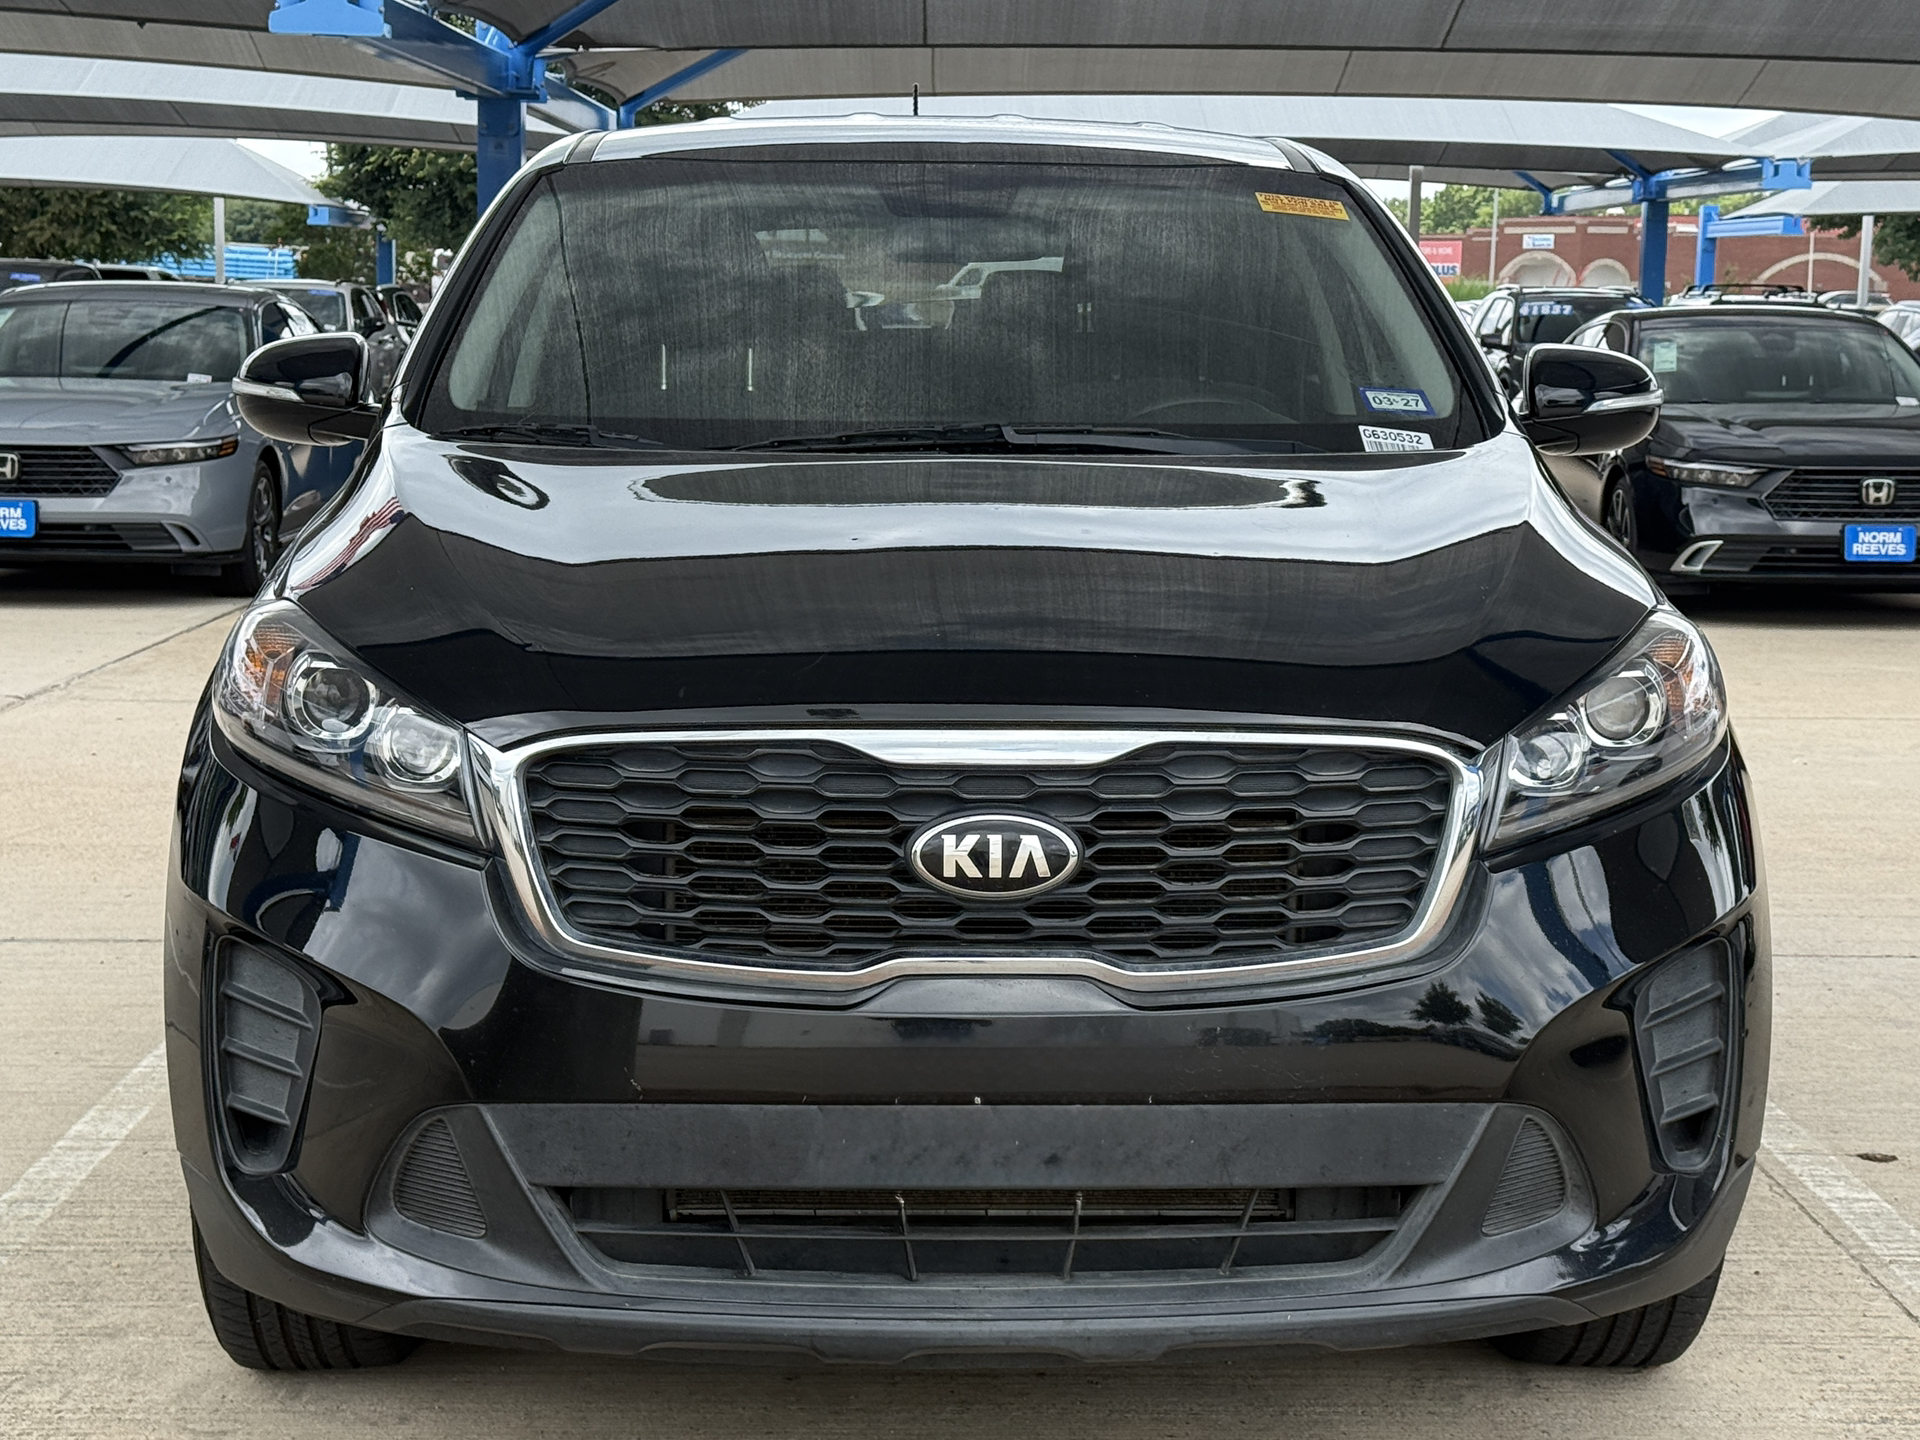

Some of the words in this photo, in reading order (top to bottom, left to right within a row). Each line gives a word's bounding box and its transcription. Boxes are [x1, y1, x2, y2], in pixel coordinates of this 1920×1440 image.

[1363, 428, 1424, 446] G630532
[0, 518, 27, 531] VES
[1858, 531, 1902, 543] NORM
[1853, 543, 1907, 556] REEVES
[941, 834, 1051, 878] KIA
